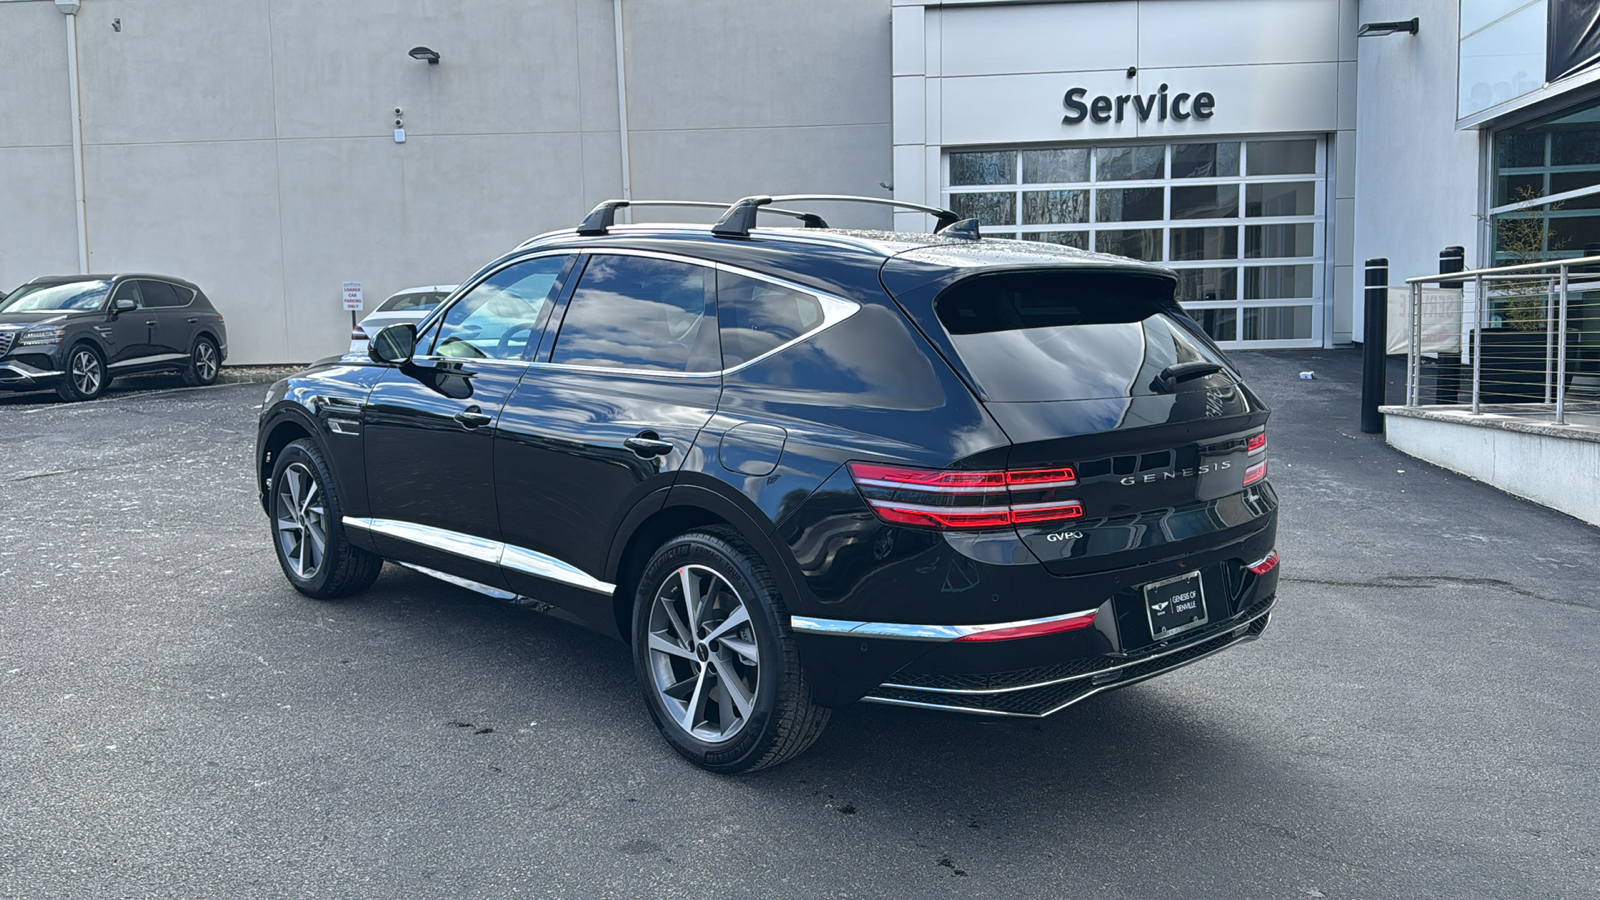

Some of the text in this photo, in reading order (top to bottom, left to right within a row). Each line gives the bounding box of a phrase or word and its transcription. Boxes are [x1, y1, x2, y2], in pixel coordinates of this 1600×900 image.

[1062, 83, 1215, 124] Service
[1120, 460, 1231, 486] GENESIS
[725, 562, 742, 580] TOUR
[1172, 590, 1197, 603] GENESIS OF
[1176, 601, 1197, 613] DENVILLE
